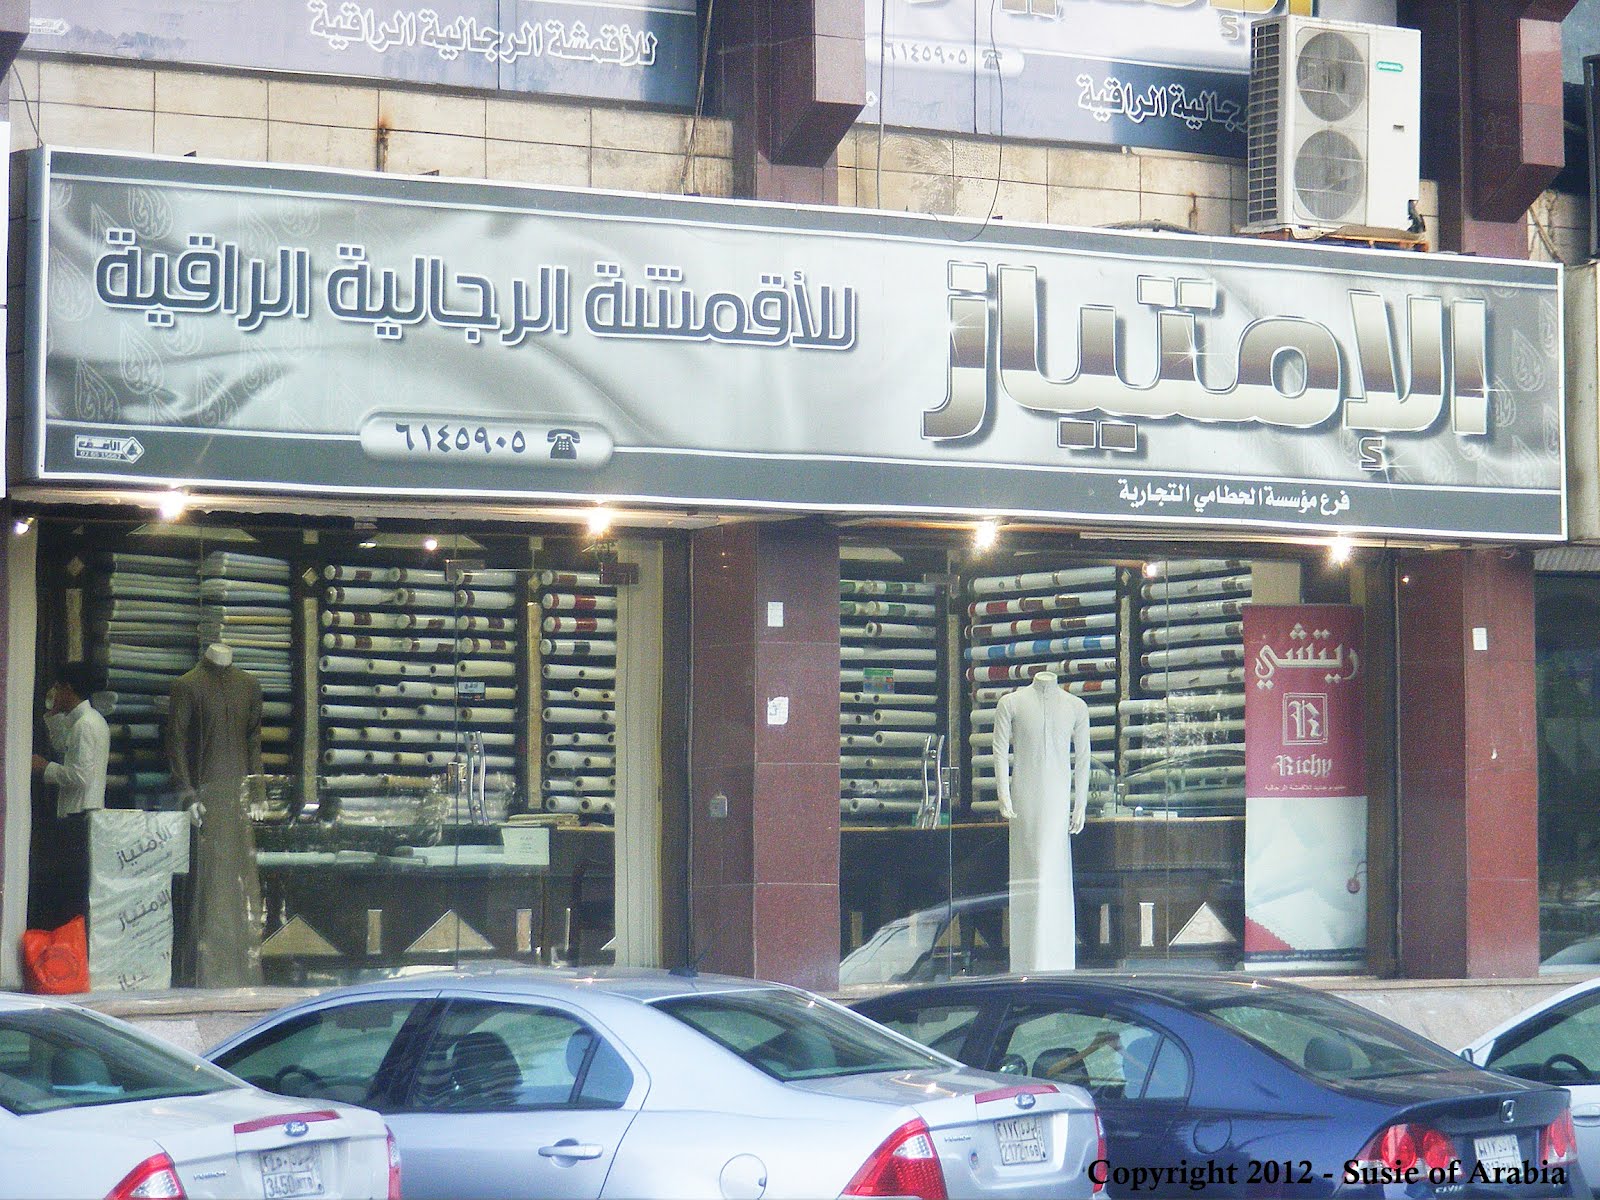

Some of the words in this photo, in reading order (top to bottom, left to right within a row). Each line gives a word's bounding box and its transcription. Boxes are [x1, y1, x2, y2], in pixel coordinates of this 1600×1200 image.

[308, 0, 416, 52] الراقية
[421, 9, 544, 64] الرجالية
[547, 20, 658, 66] للأقمشة
[884, 42, 968, 64] ٦١٤٥٩٠٥
[1076, 73, 1168, 123] الراقية
[95, 228, 310, 331] الراقية
[327, 244, 569, 346] الرجالية
[585, 263, 857, 350] للأقمشة
[921, 260, 1487, 471] الإمتياز
[395, 422, 526, 454] ٦١٤٥٩٠٥
[1118, 479, 1190, 508] التجارية
[1263, 485, 1317, 513] مؤسسة
[1320, 490, 1350, 516] فرع
[1275, 753, 1333, 777] Richy
